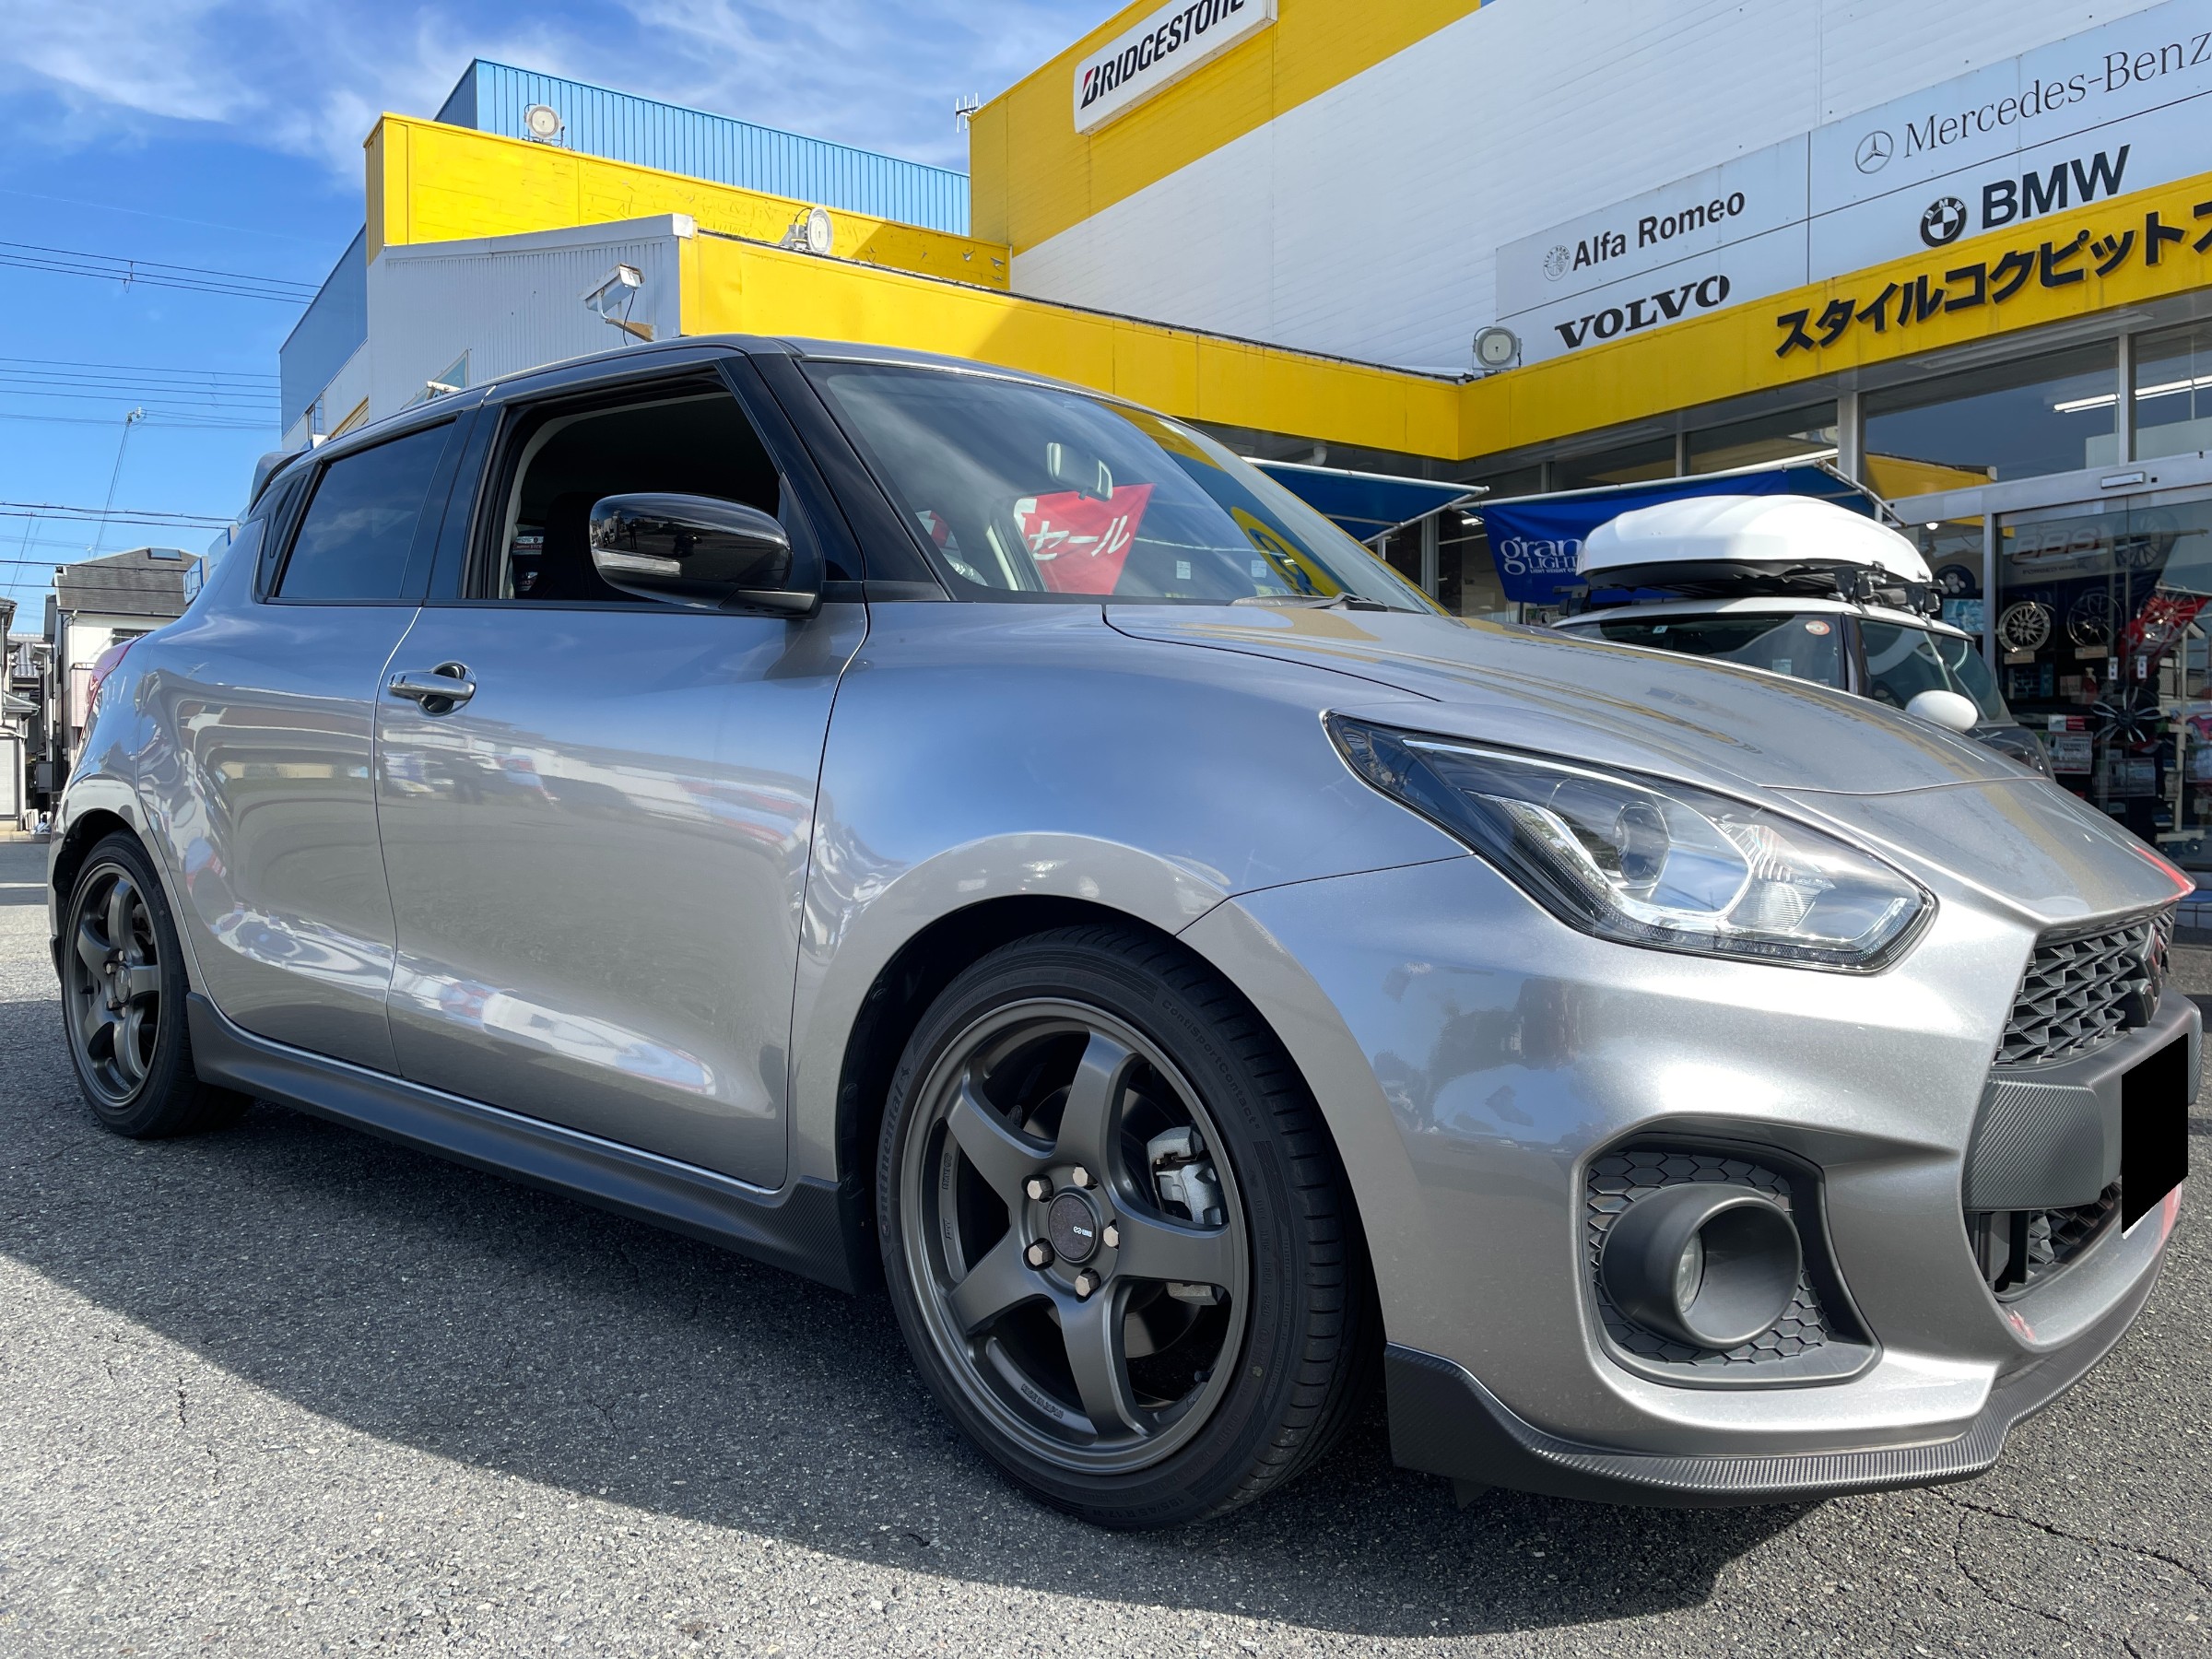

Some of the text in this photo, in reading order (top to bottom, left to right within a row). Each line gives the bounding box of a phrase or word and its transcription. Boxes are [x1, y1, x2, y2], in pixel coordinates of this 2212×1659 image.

[1904, 31, 2212, 159] Mercedes-Benz
[1982, 144, 2131, 230] BMW
[1572, 191, 1745, 271] Alfa Romeo
[1554, 275, 1730, 349] VOLVO
[1028, 515, 1130, 560] セール
